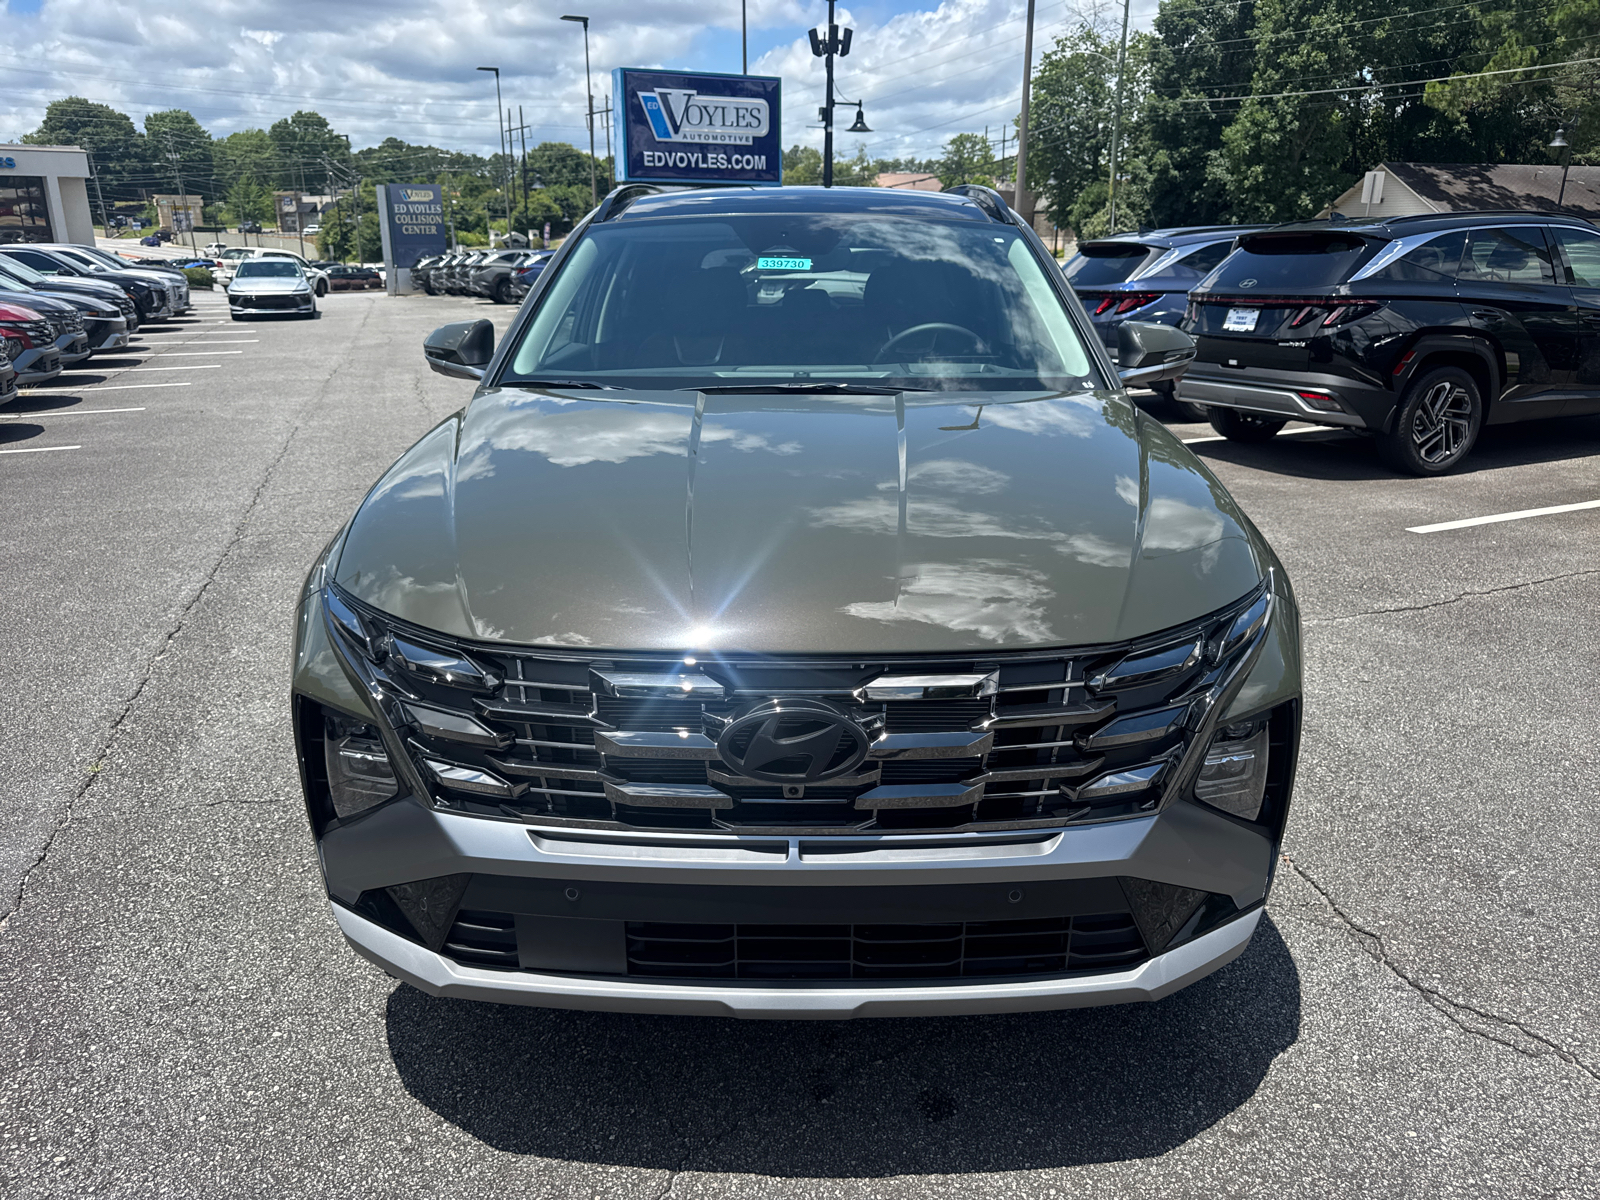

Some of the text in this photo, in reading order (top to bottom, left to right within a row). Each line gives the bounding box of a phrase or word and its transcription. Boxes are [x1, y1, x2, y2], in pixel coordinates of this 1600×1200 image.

[658, 92, 761, 134] VOYLES
[682, 134, 750, 143] AUTOMOTIVE
[643, 151, 766, 170] EDVOYLES.COM
[394, 204, 442, 214] ED VOYLES
[395, 214, 442, 224] COLLISION
[402, 225, 438, 234] CENTER
[762, 260, 804, 268] 339730
